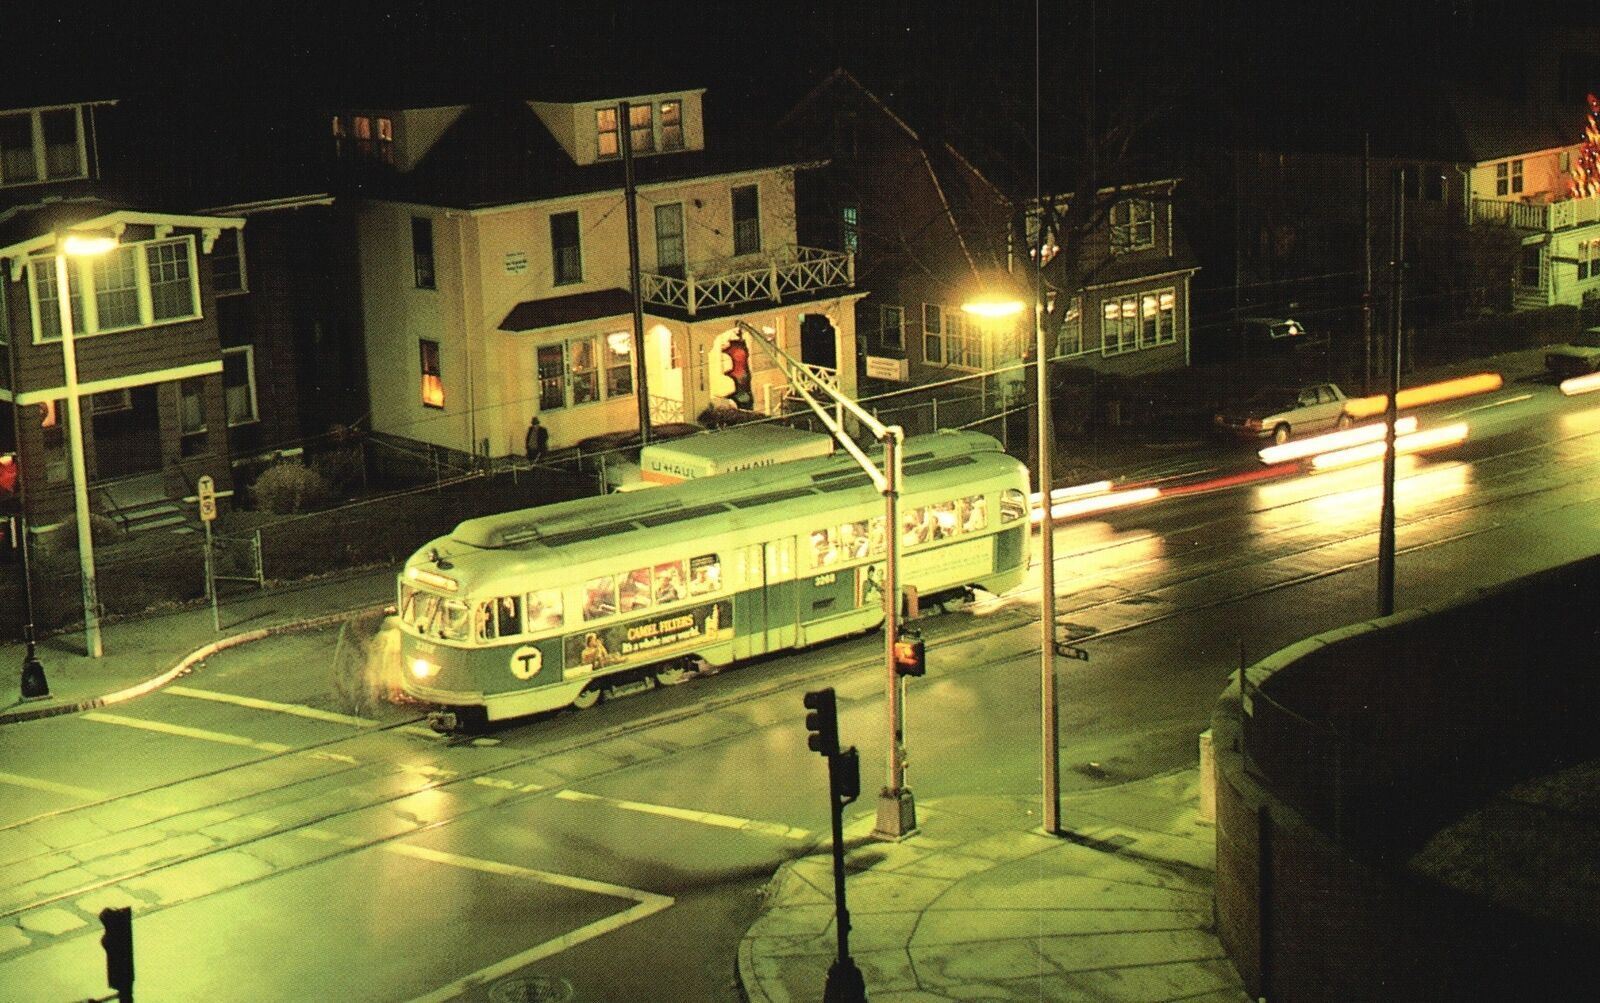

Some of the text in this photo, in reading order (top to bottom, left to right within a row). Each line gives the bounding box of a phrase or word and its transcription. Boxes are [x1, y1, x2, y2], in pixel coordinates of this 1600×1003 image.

[628, 614, 694, 641] CAMEL FILTERS
[639, 637, 661, 650] whole
[517, 653, 537, 673] T
